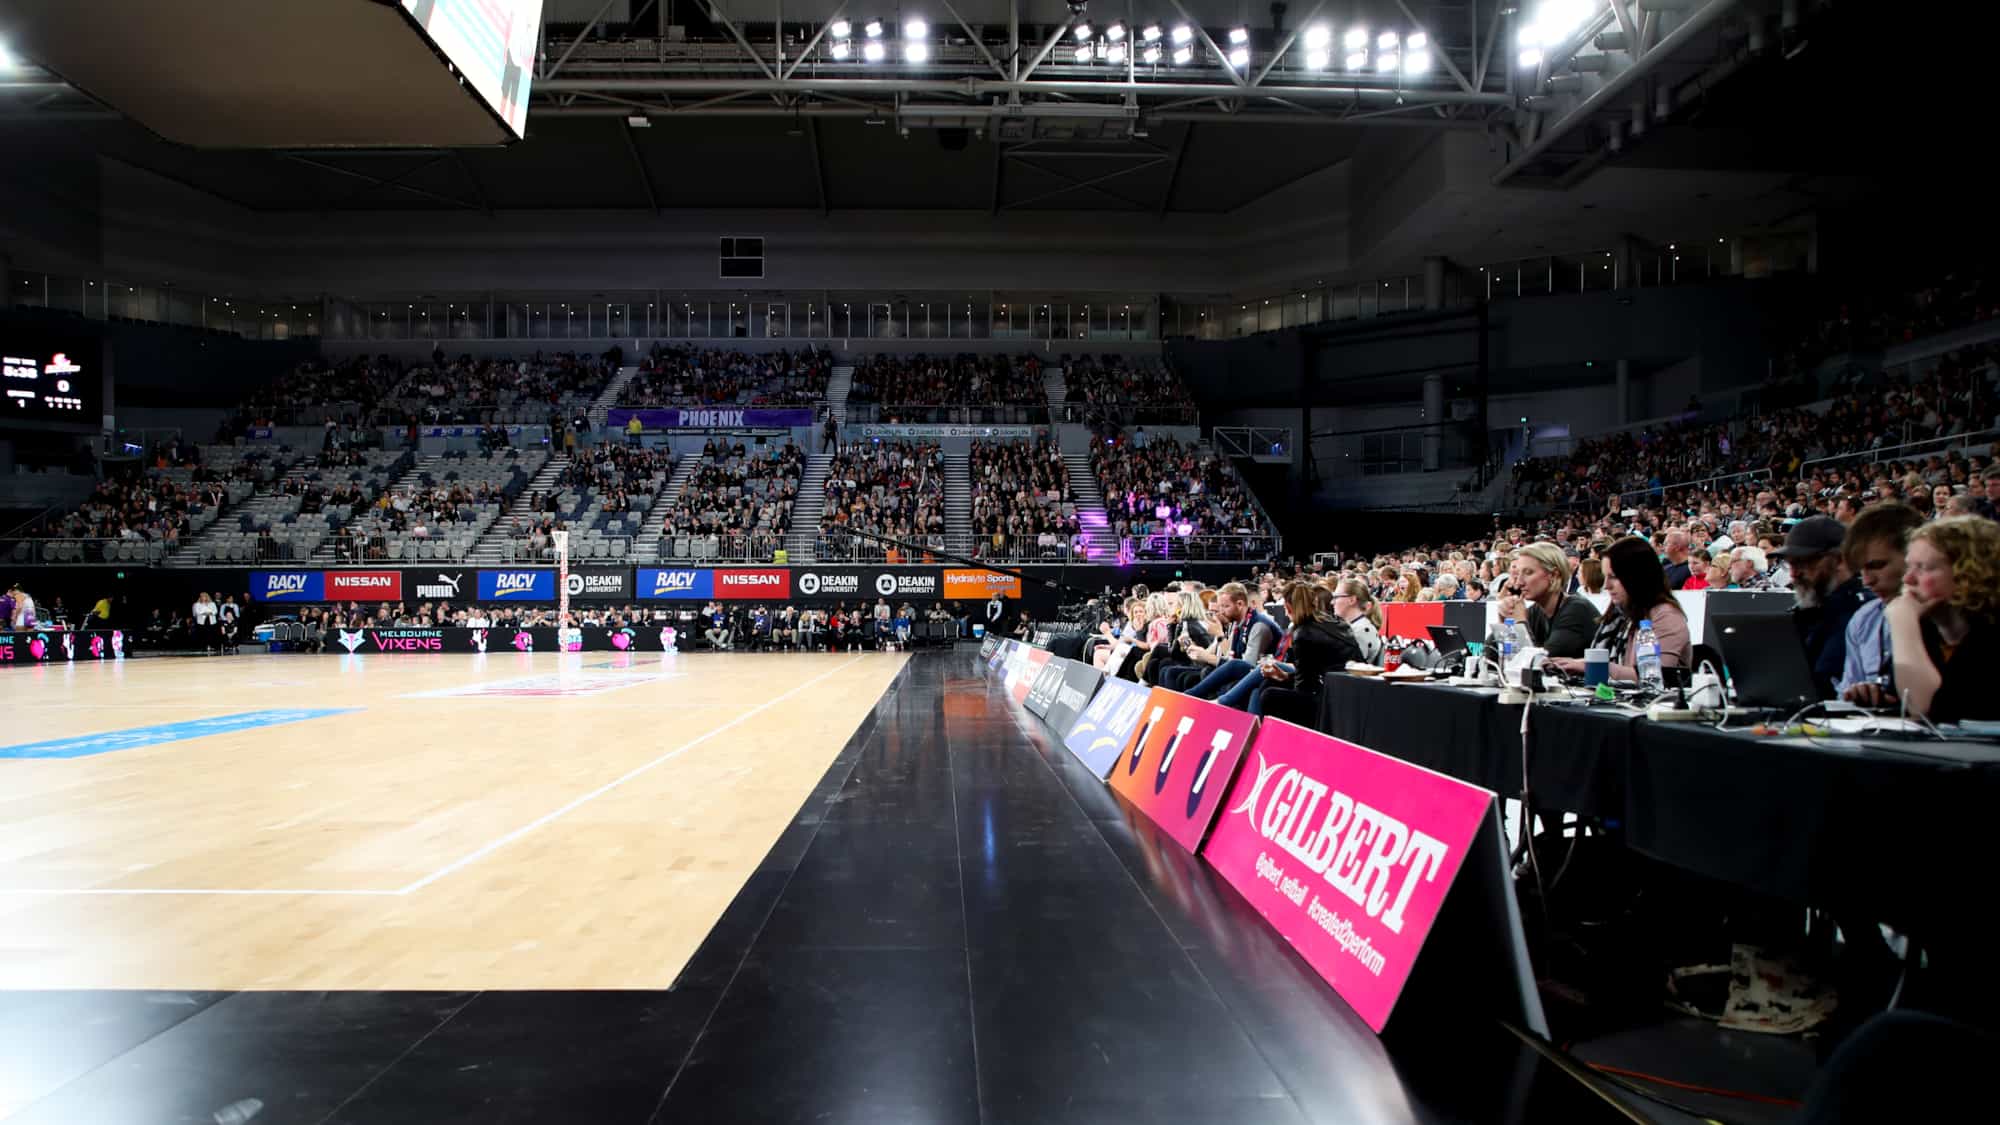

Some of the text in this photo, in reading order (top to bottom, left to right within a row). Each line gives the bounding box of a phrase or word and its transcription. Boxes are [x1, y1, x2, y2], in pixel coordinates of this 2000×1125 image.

[679, 410, 744, 426] PHOENIX
[268, 574, 307, 590] RACV
[334, 576, 391, 587] NISSAN
[496, 573, 536, 589] RACV
[585, 575, 622, 586] DEAKIN
[656, 572, 696, 587] RACV
[722, 575, 780, 585] NISSAN
[821, 575, 858, 586] DEAKIN
[898, 576, 935, 587] DEAKIN
[416, 585, 454, 598] PUMA
[585, 585, 622, 593] UNIVERSITY
[0, 635, 15, 644] NE
[371, 631, 443, 650] VIXENS
[1260, 768, 1449, 934] GILBERT
